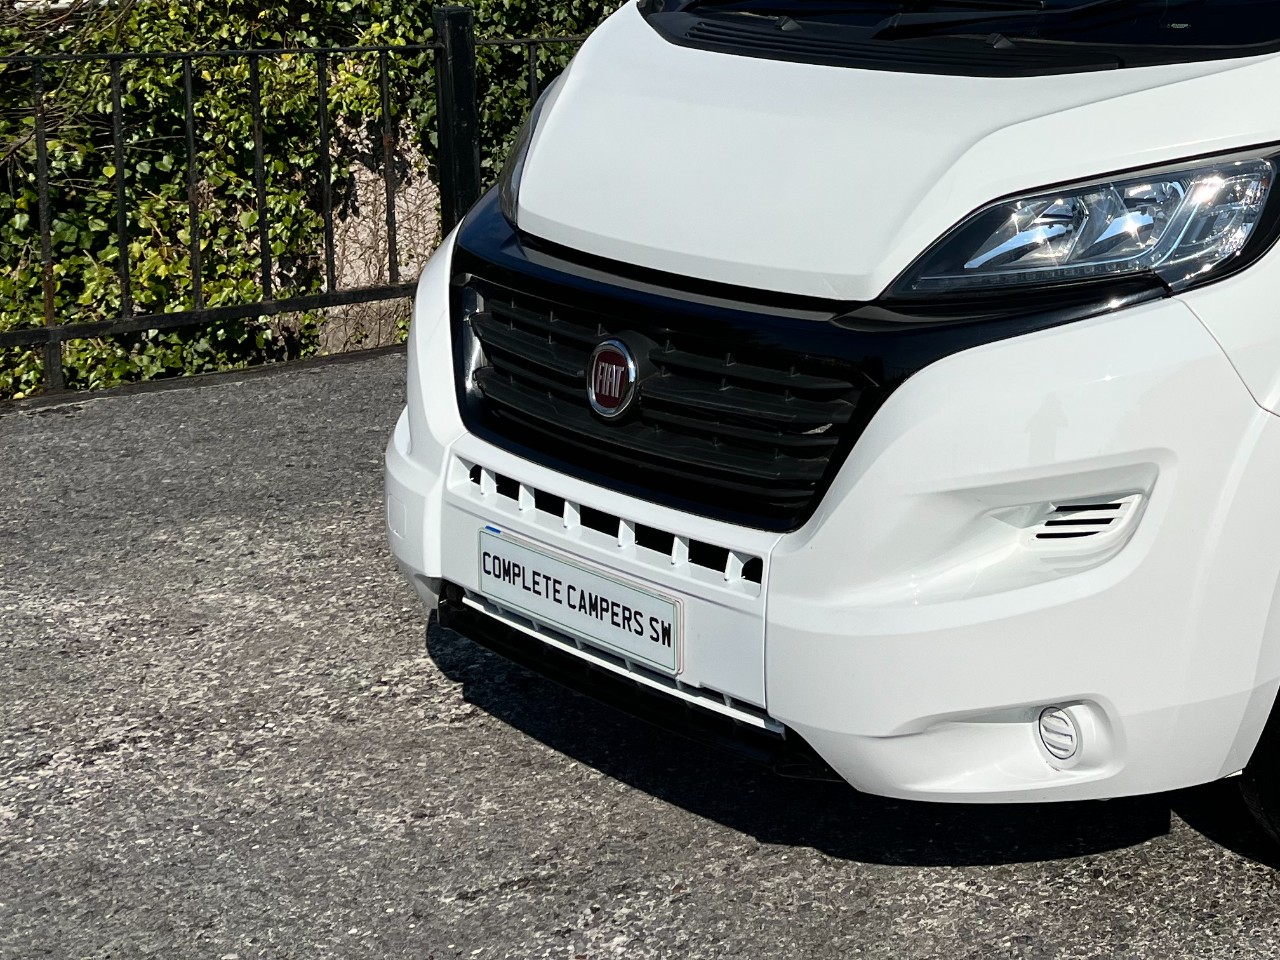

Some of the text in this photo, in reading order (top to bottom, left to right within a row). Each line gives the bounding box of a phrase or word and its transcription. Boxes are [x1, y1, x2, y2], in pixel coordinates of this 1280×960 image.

[595, 361, 625, 398] FIAT
[482, 551, 672, 648] COMPLETE CAMPERS SW
